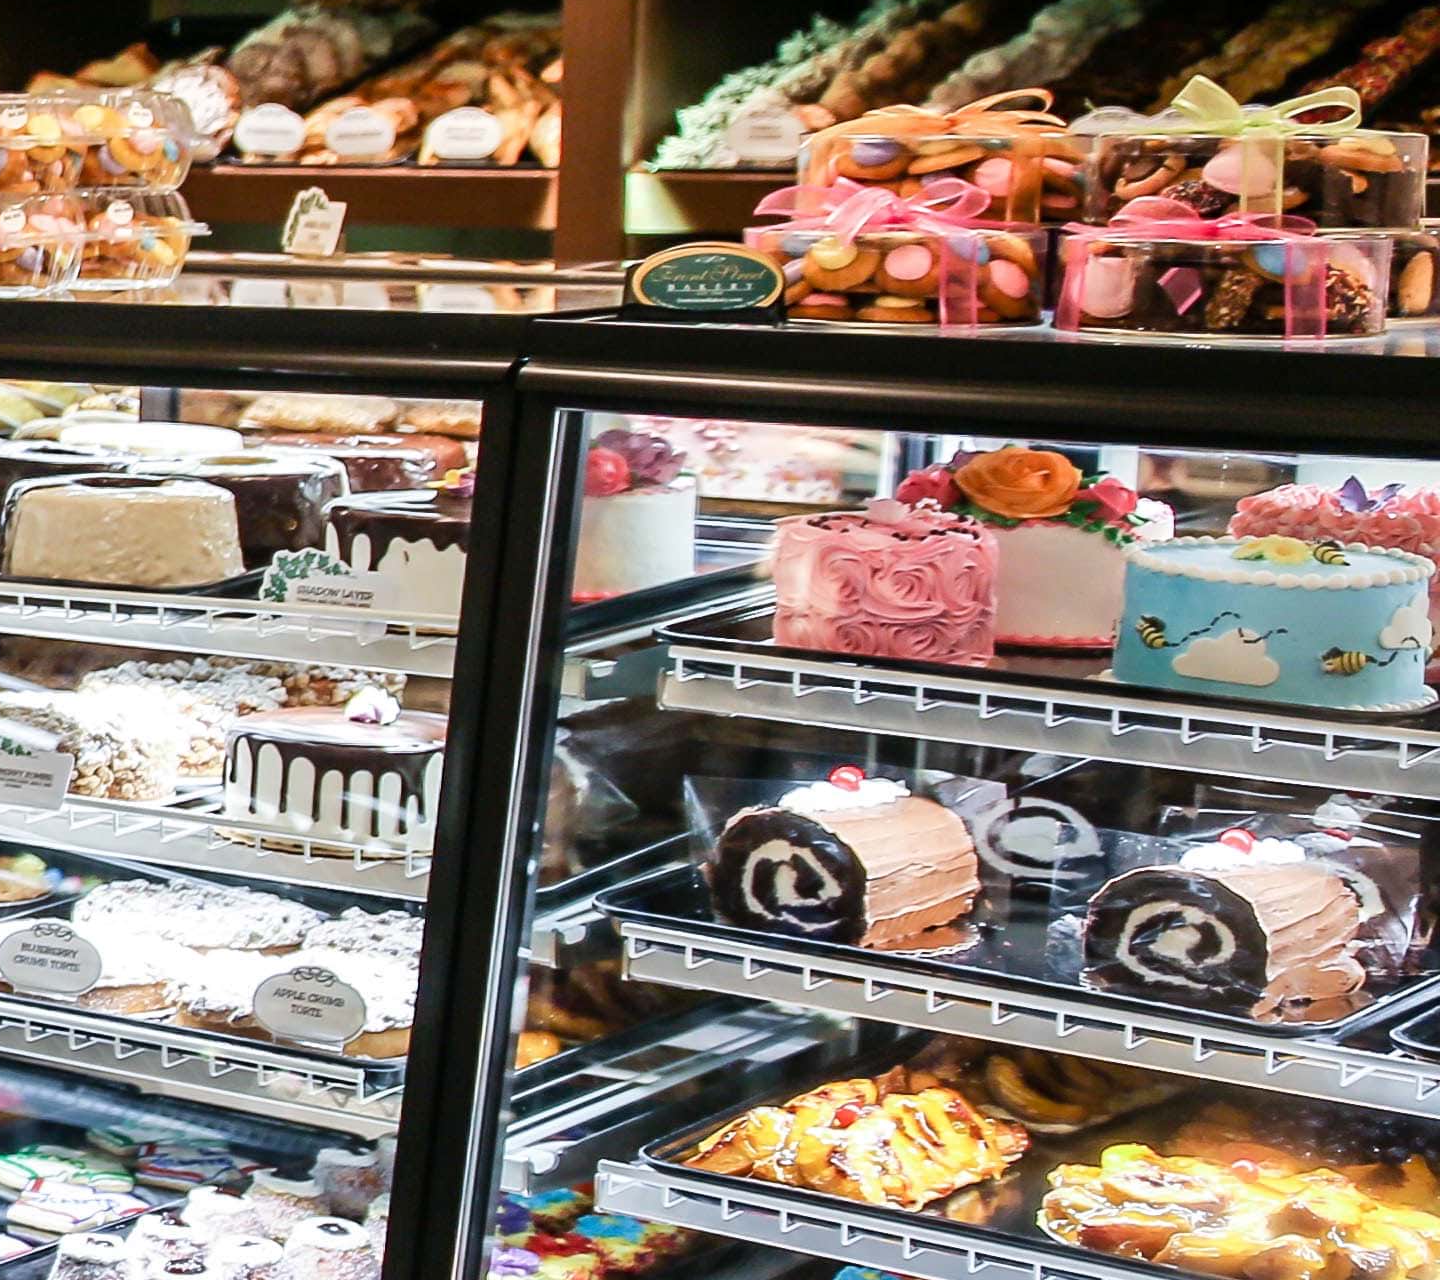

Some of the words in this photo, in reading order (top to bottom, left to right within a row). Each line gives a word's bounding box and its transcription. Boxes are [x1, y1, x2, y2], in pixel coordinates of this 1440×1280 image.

[296, 584, 341, 597] SHADOW
[342, 588, 375, 600] LAYER
[20, 942, 79, 958] BLUEBERRY
[13, 954, 48, 968] CRUMB
[49, 959, 81, 973] TORTE
[272, 987, 306, 1001] APPLE
[307, 992, 345, 1007] CRUMB
[290, 1003, 323, 1018] TORTE
